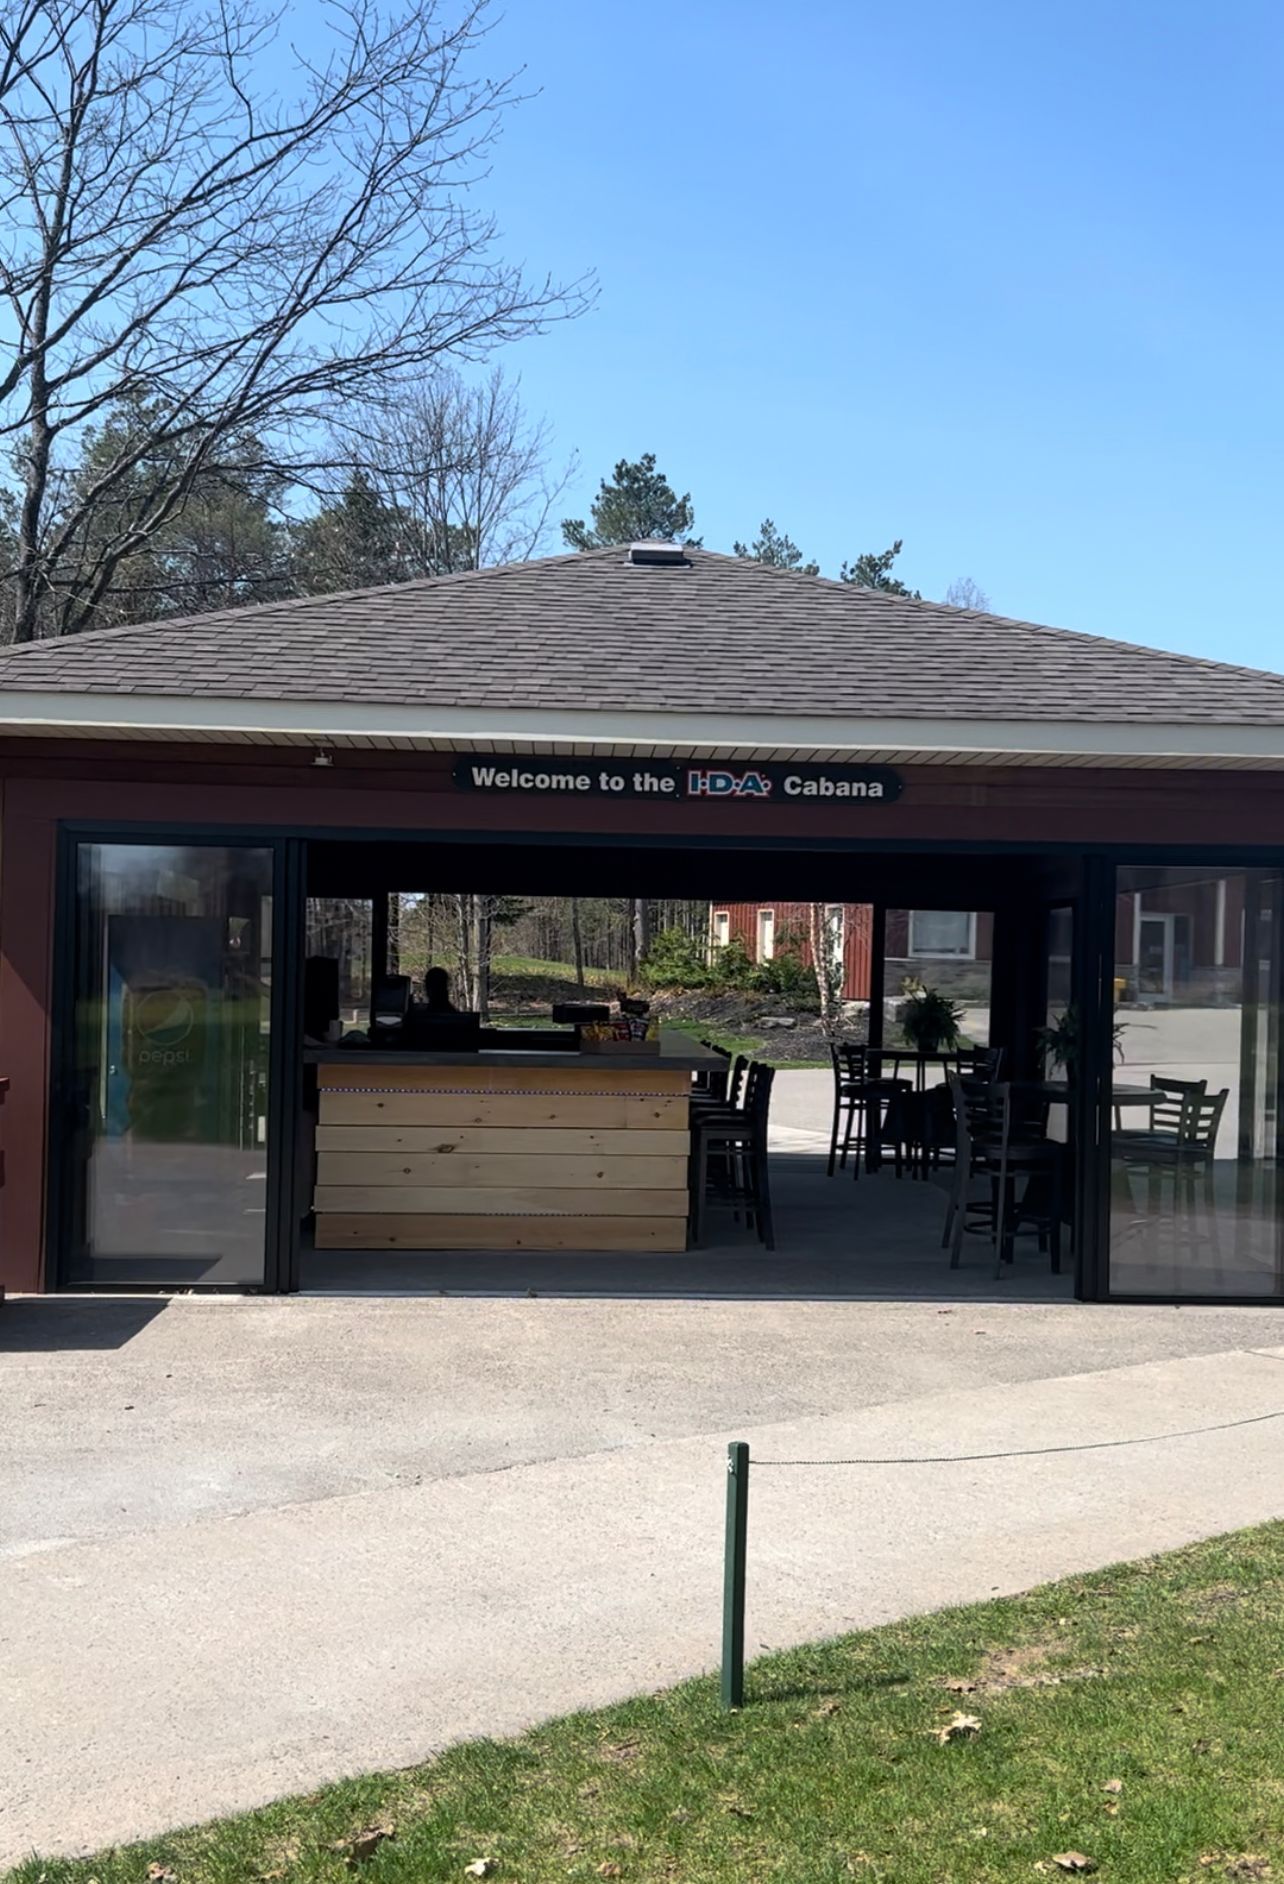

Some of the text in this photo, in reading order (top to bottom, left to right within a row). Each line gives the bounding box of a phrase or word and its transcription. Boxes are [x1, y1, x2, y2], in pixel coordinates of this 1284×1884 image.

[472, 767, 591, 790] Welcome
[599, 771, 625, 792] to
[632, 772, 676, 793] the
[783, 776, 884, 799] Cabana
[138, 1049, 191, 1067] pepsi
